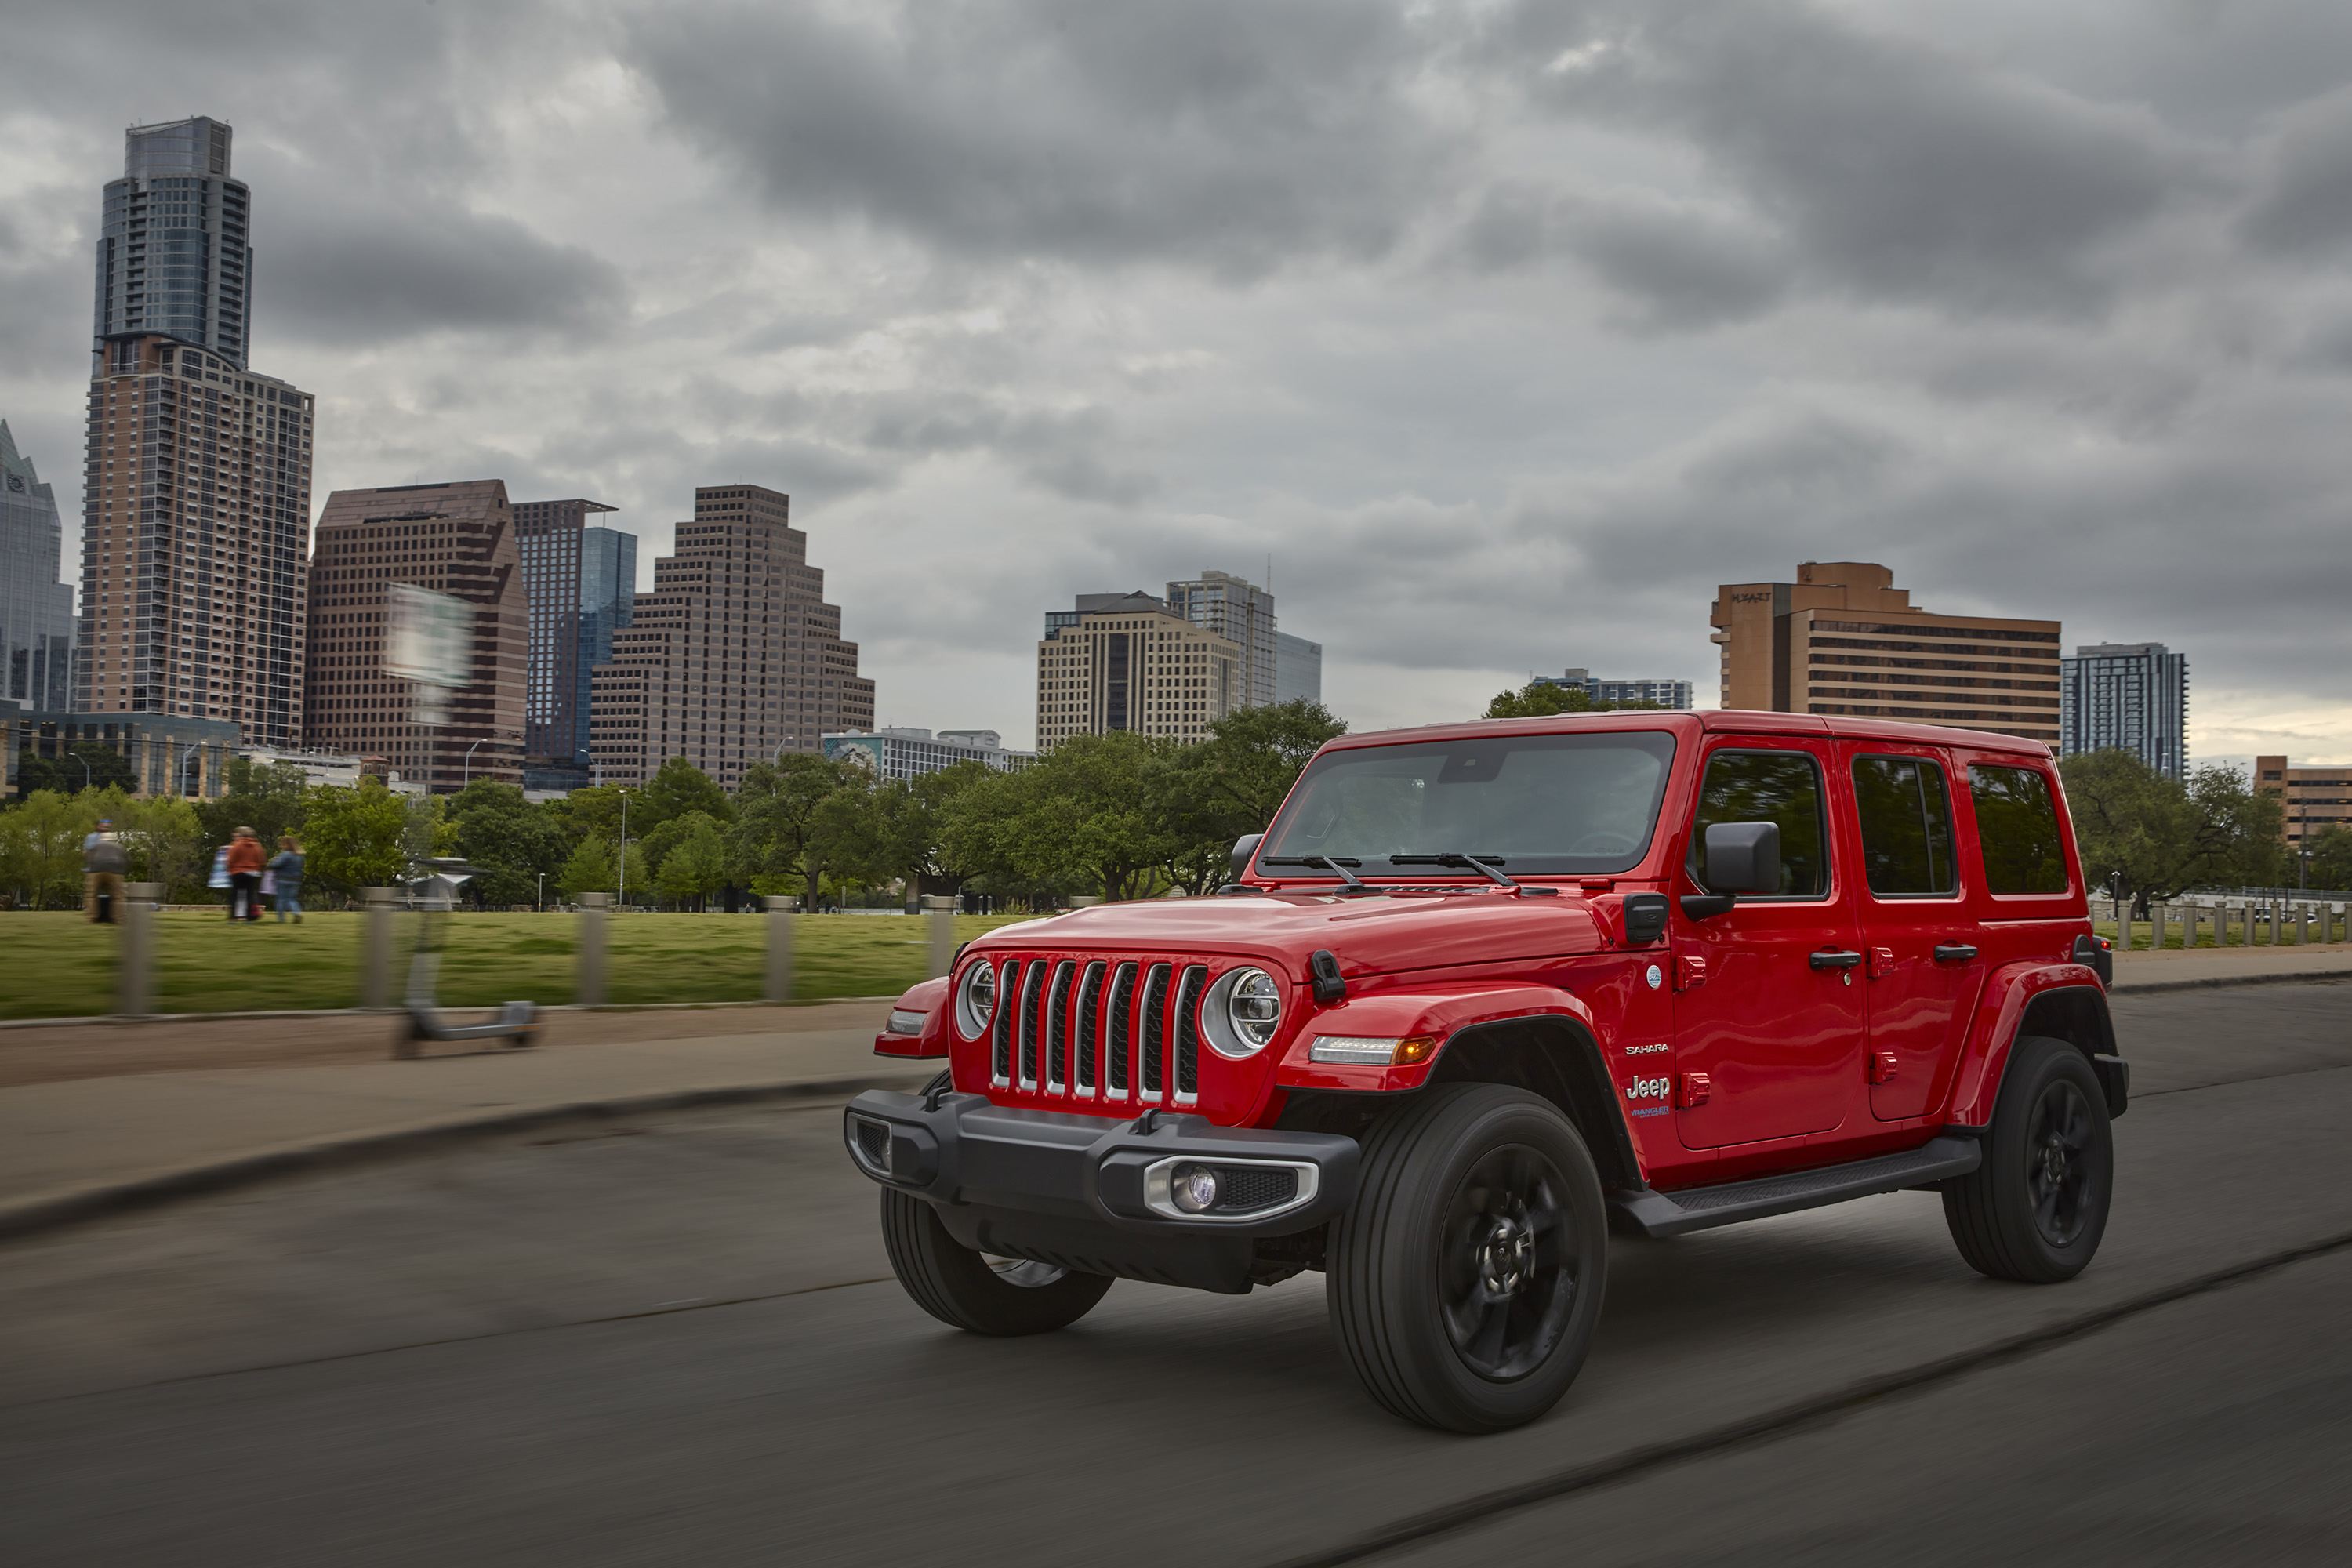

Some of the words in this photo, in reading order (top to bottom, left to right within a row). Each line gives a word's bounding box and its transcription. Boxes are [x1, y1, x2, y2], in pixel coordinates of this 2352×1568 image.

[1731, 592, 1771, 603] HYATT
[1625, 1044, 1669, 1054] SAHARA
[1626, 1075, 1670, 1100] Jeep
